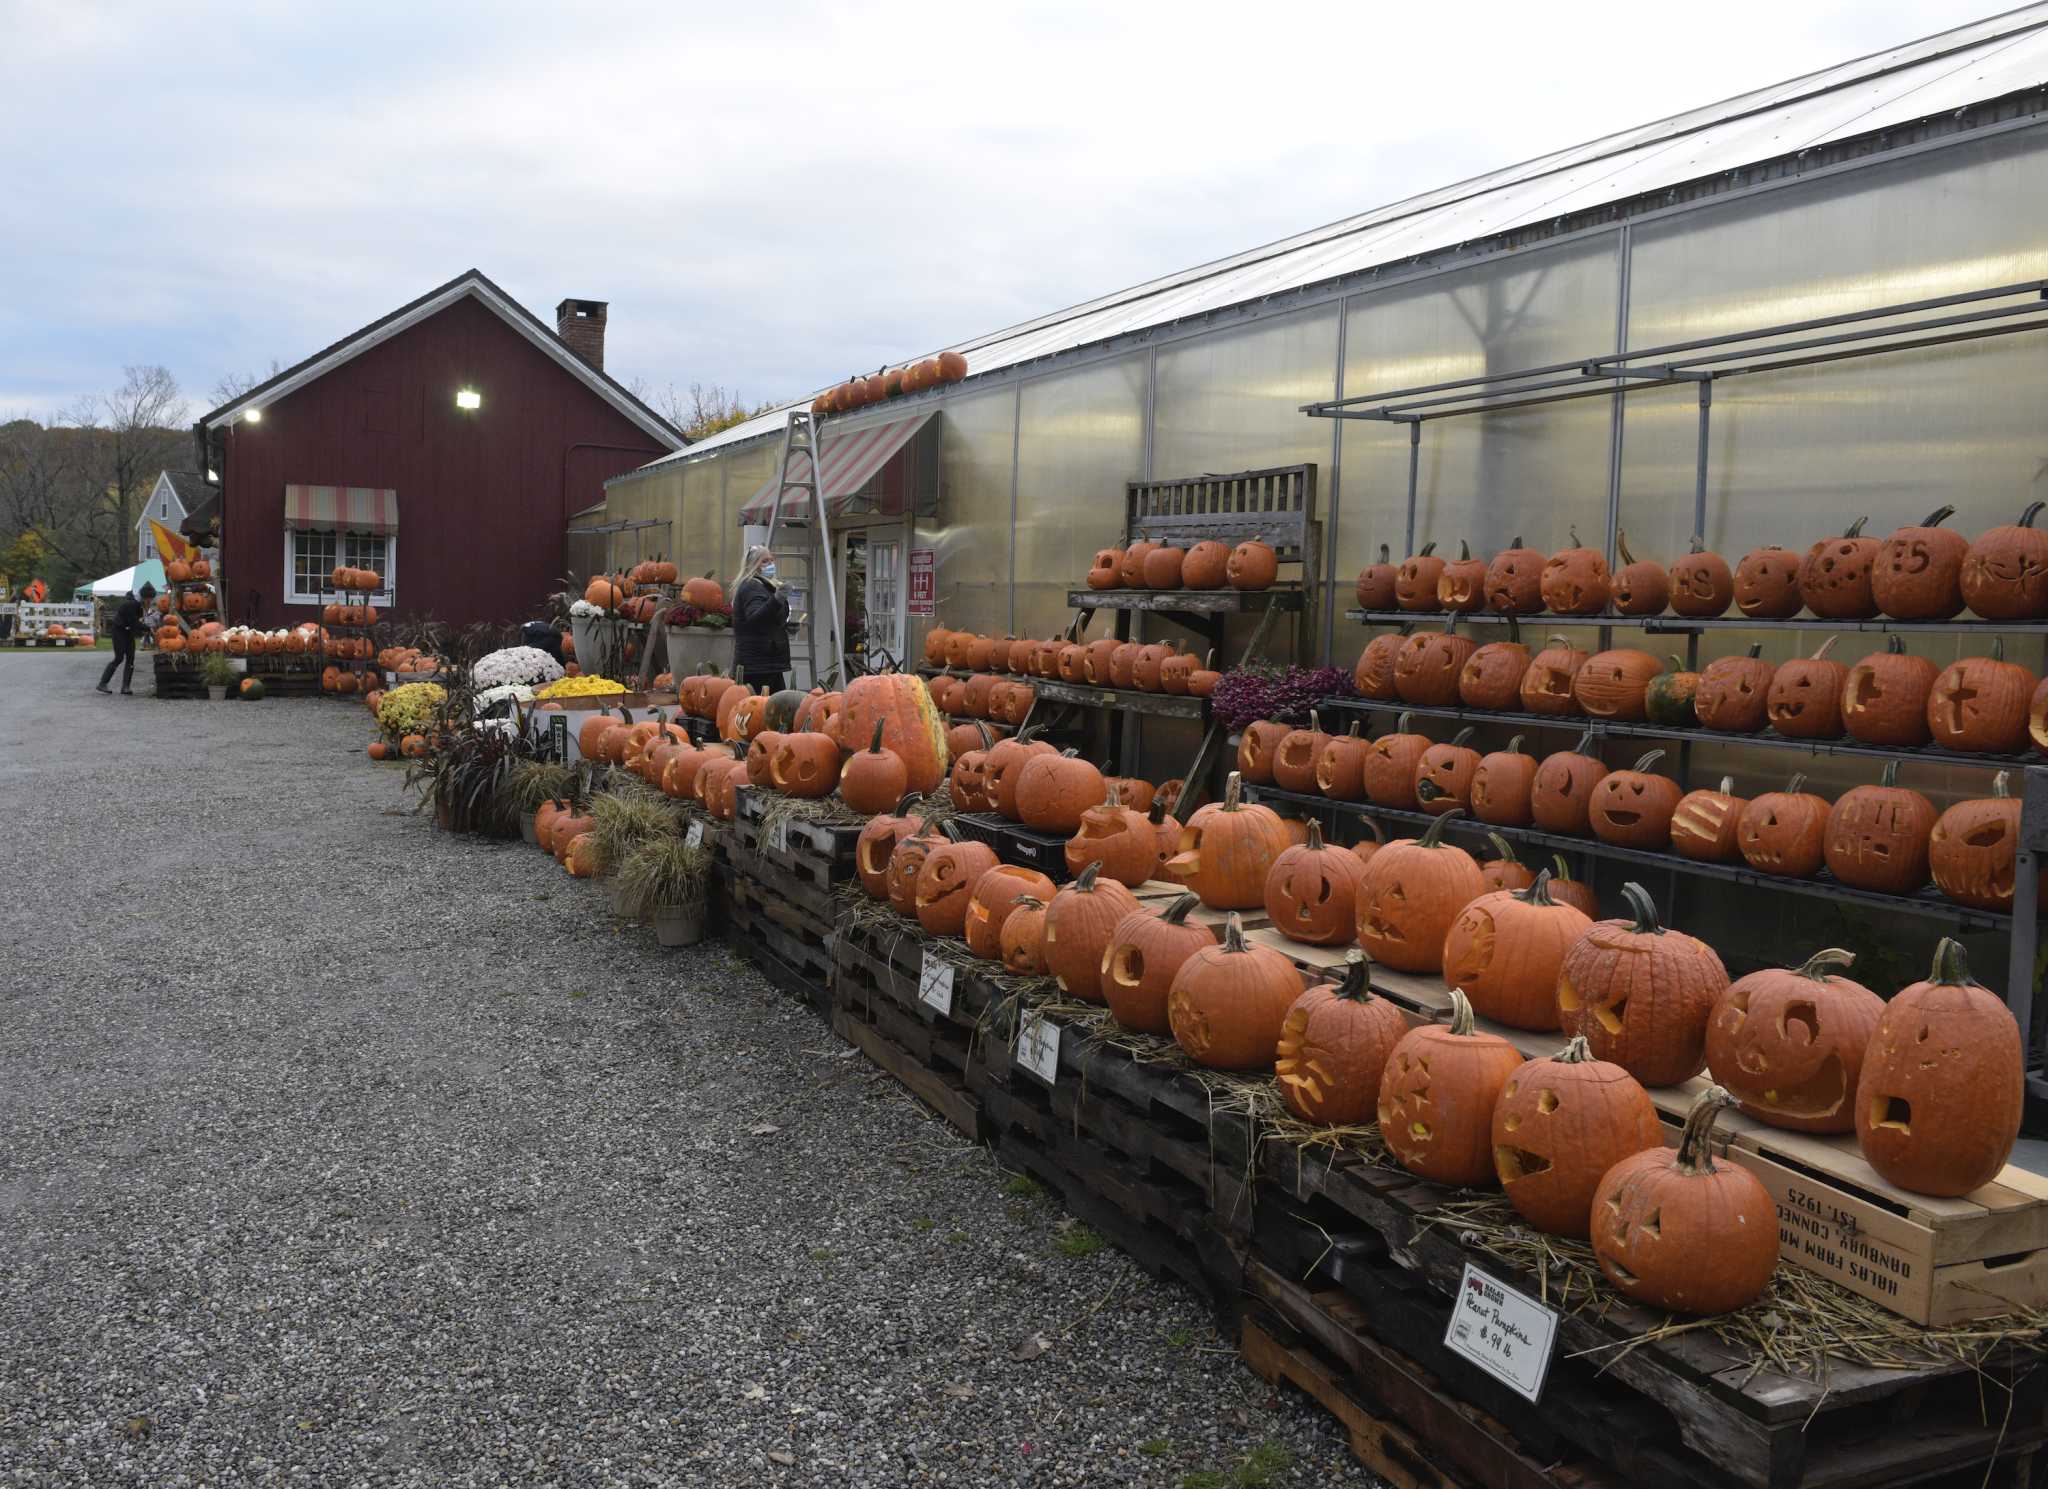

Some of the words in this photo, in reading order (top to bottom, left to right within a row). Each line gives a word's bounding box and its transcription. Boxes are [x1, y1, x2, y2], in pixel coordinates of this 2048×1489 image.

[1788, 1188, 1821, 1215] 1925
[1829, 1205, 1857, 1231] EST.
[1805, 1240, 1843, 1270] FARM
[1836, 1230, 1911, 1279] DANBURY,
[1850, 1262, 1898, 1296] HALAS
[1466, 1292, 1490, 1318] Peanut
[1491, 1308, 1532, 1346] Pumpkins
